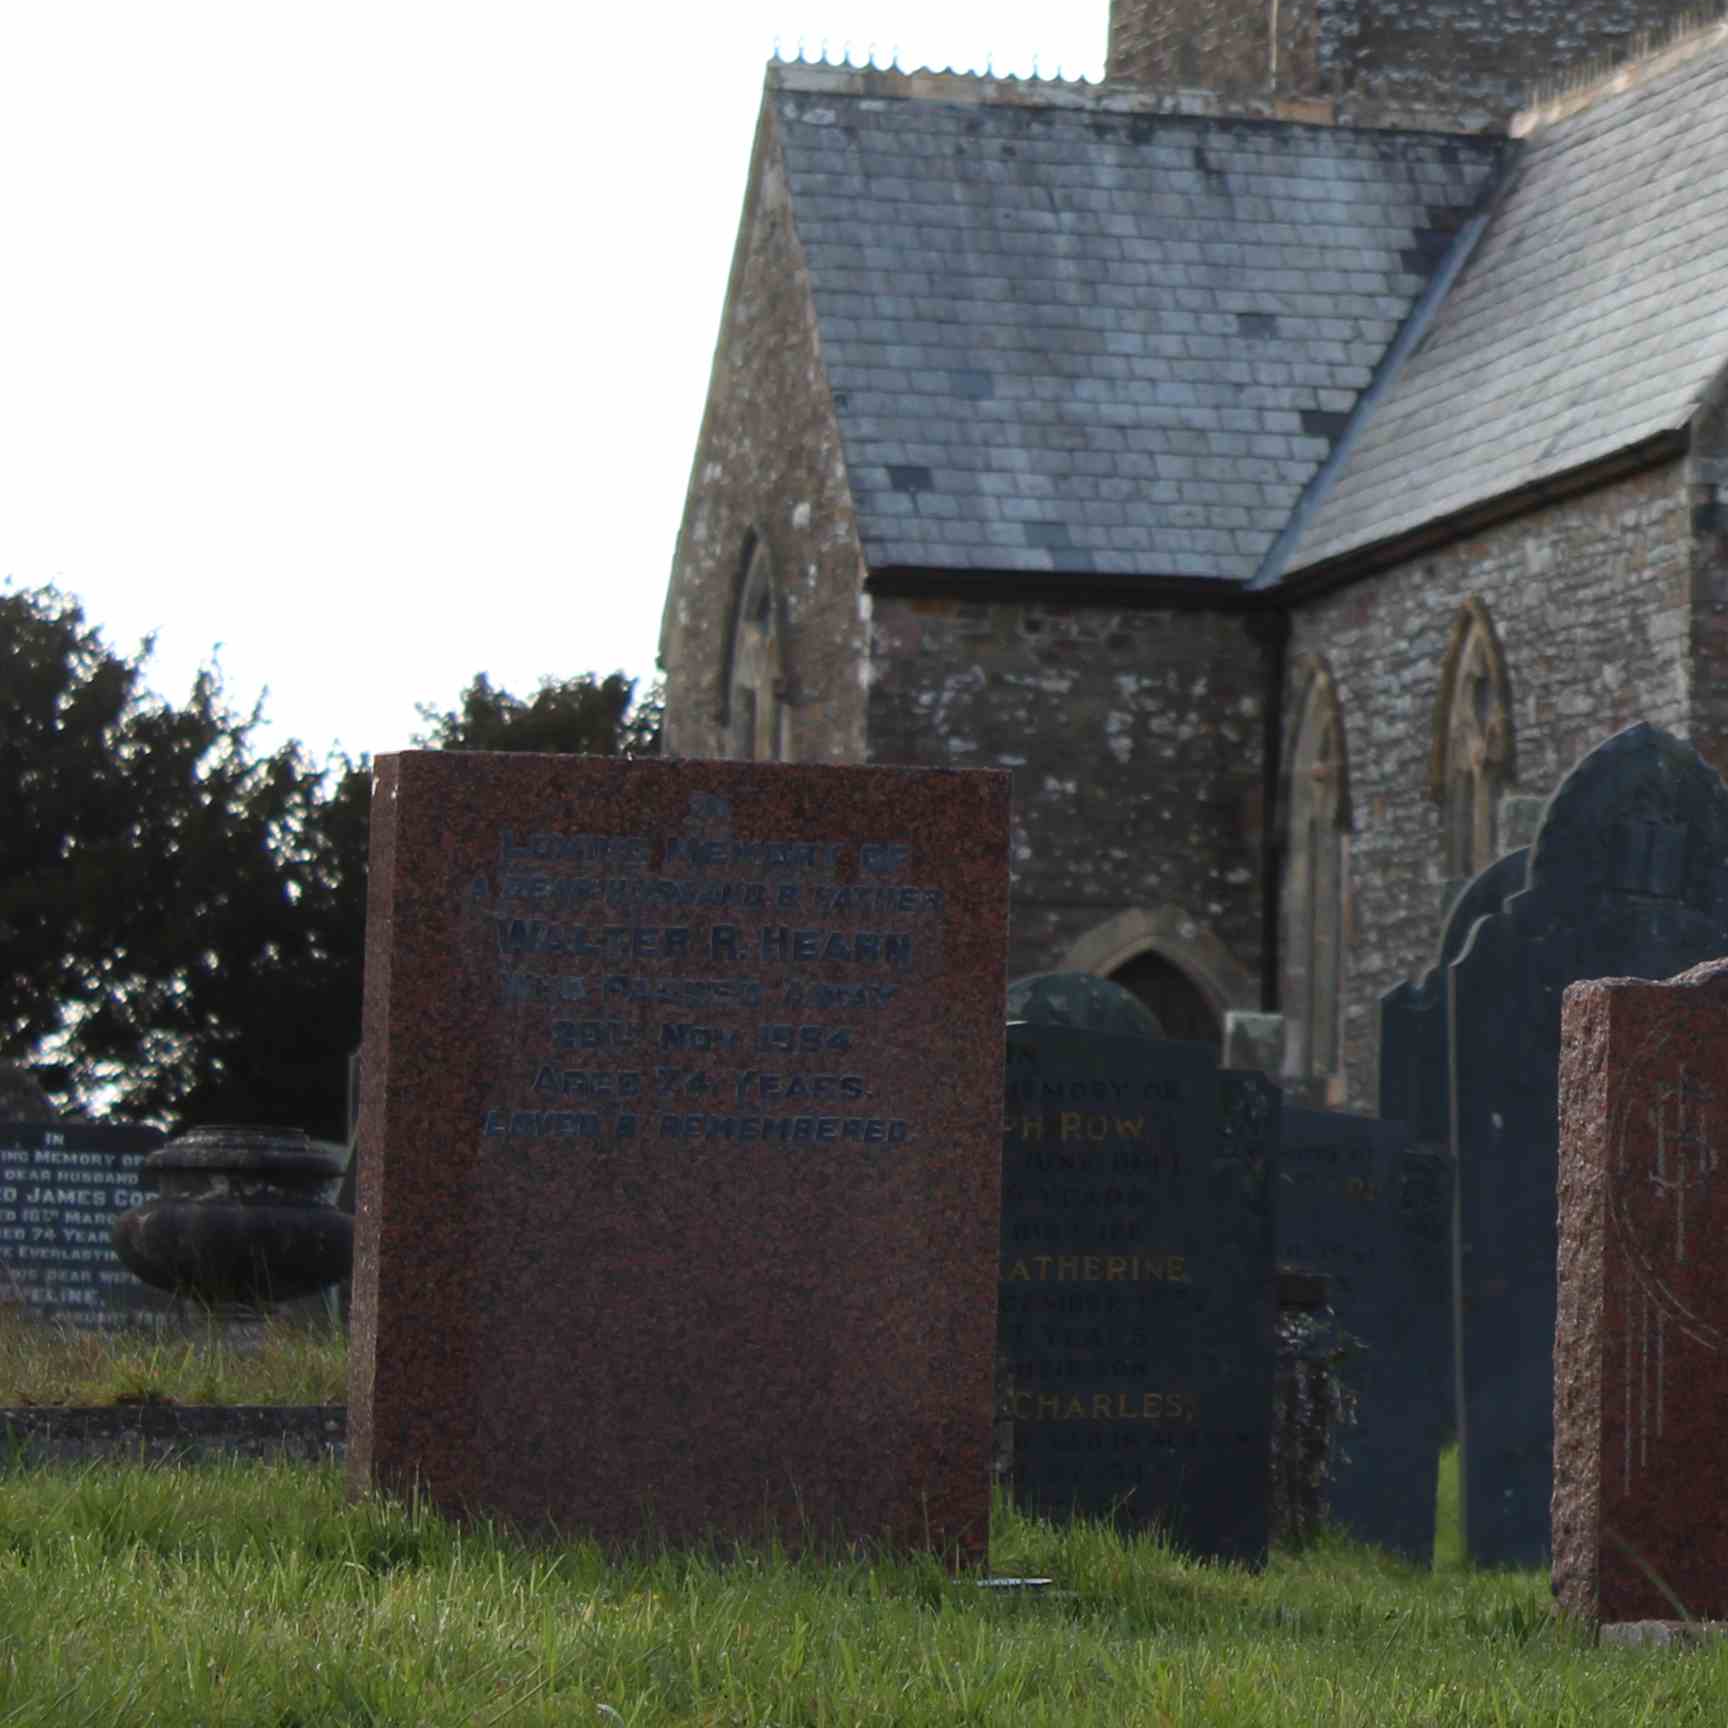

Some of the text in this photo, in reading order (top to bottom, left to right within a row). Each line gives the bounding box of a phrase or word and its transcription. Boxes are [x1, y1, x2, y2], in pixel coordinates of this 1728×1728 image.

[497, 919, 688, 959] WALTER
[760, 927, 914, 964] HEARN
[1060, 1112, 1146, 1143] ROW
[35, 1150, 115, 1167] MEMORY
[4, 1169, 139, 1185] DEAR HUSBAND
[26, 1187, 107, 1208] JAMES
